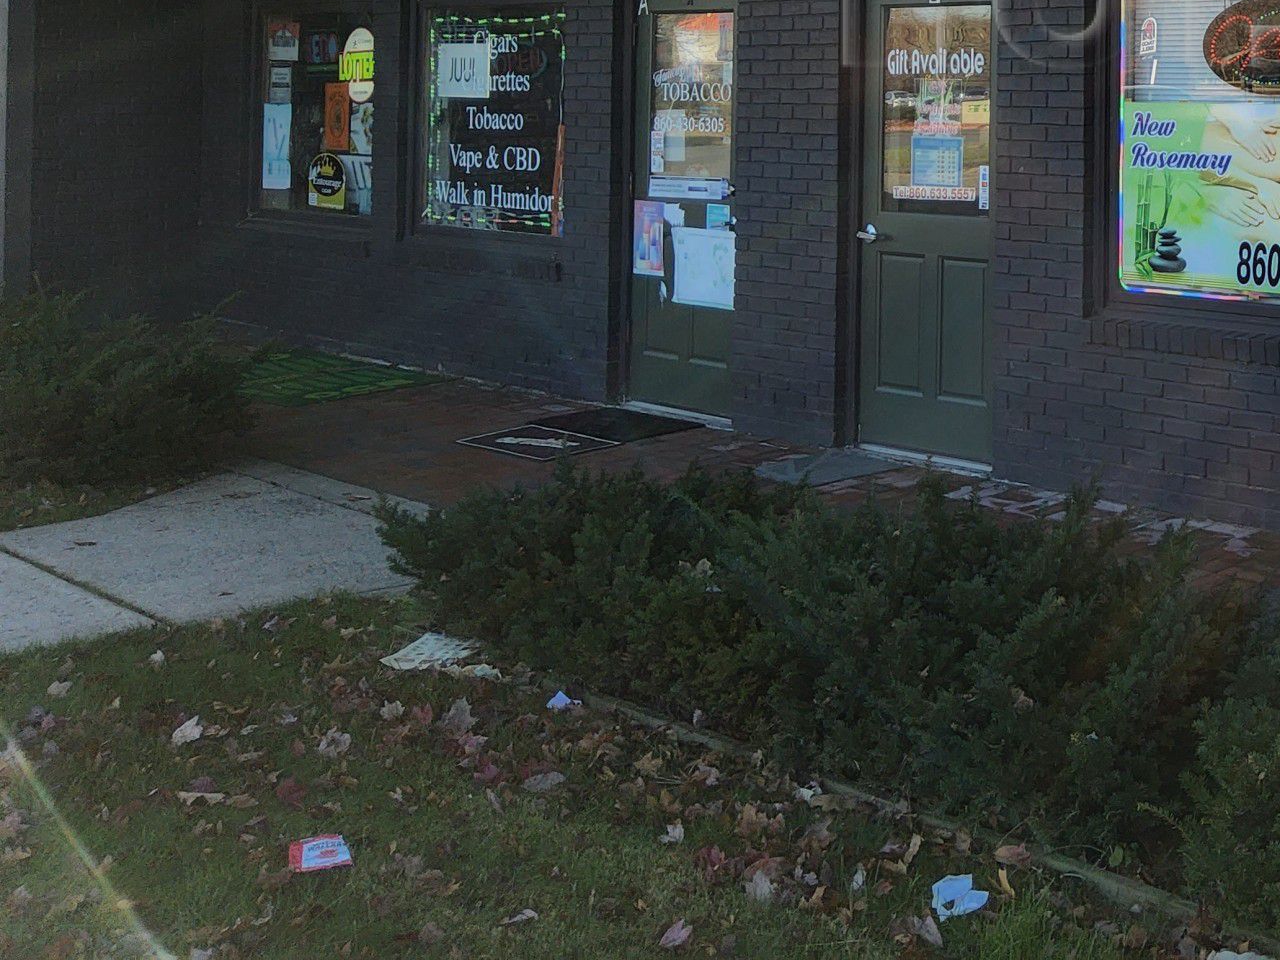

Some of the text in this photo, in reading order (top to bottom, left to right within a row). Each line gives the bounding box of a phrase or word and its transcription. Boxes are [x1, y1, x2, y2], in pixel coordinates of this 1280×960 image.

[888, 48, 908, 75] Gift
[661, 82, 732, 102] TOBACCO
[466, 106, 524, 131] Tobacco
[1131, 111, 1177, 138] New
[449, 143, 541, 174] Vape & CBD
[1130, 142, 1233, 176] Rosemary
[436, 180, 555, 212] Walk in Humidor
